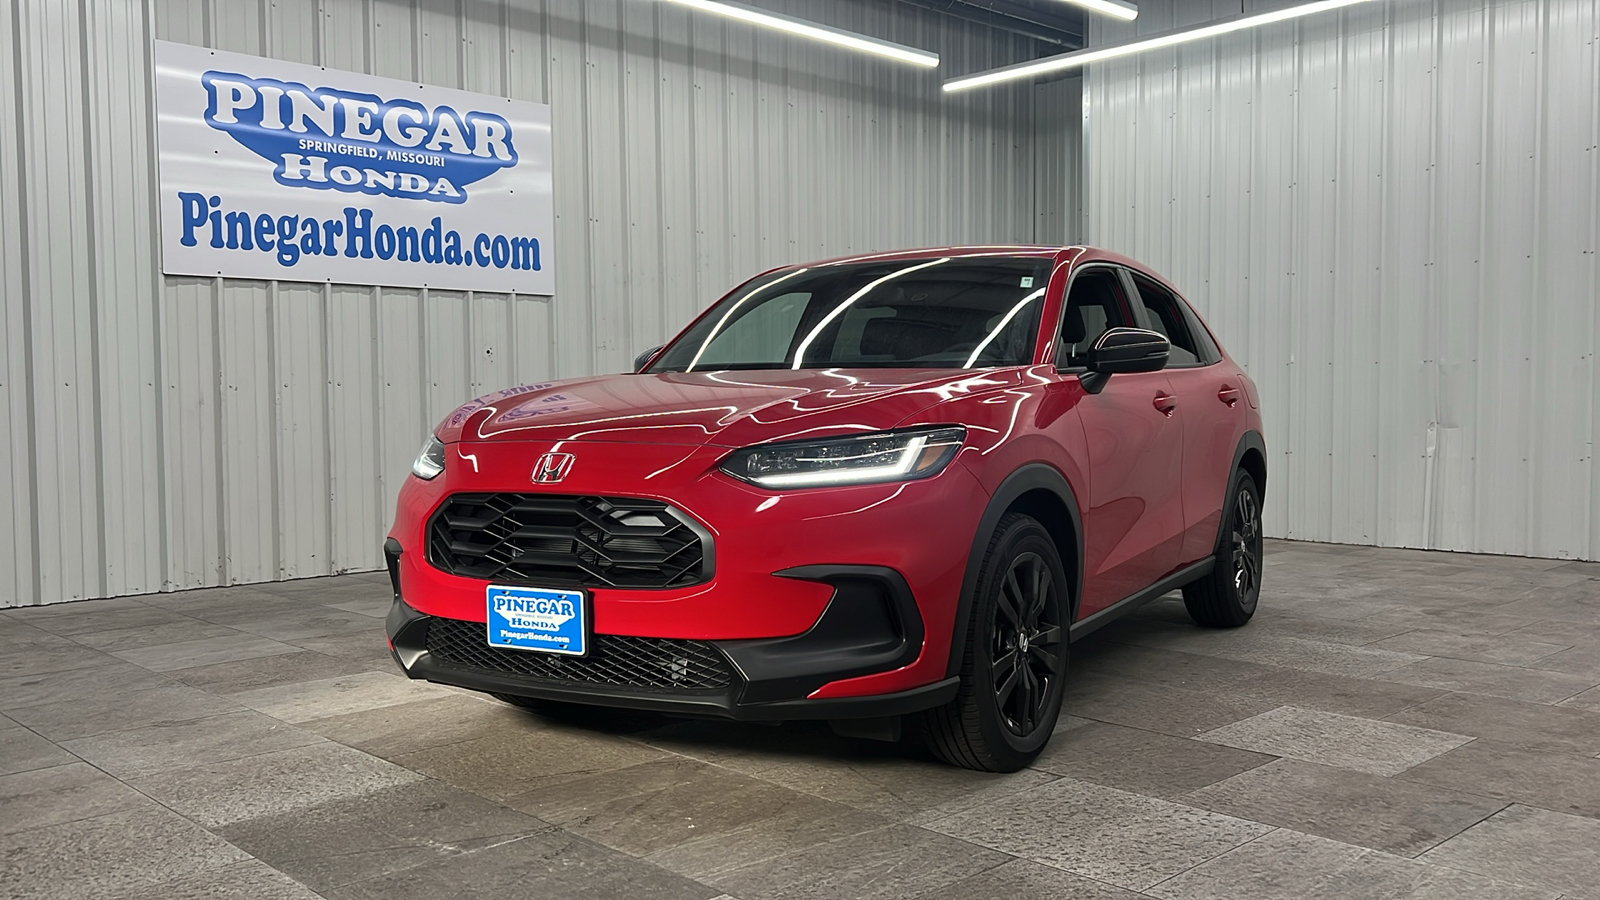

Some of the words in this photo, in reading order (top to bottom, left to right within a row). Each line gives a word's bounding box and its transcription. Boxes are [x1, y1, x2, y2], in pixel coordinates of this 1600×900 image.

[208, 78, 513, 162] PINEGAR
[298, 138, 383, 161] SPRINGFIELD,
[386, 149, 446, 167] MISSOURI
[280, 153, 462, 198] HONDA
[177, 191, 542, 271] PinegarHonda.com
[495, 598, 573, 616] PINEGAR
[500, 629, 570, 643] PinegarHonda.com
[511, 617, 557, 629] HONDA
